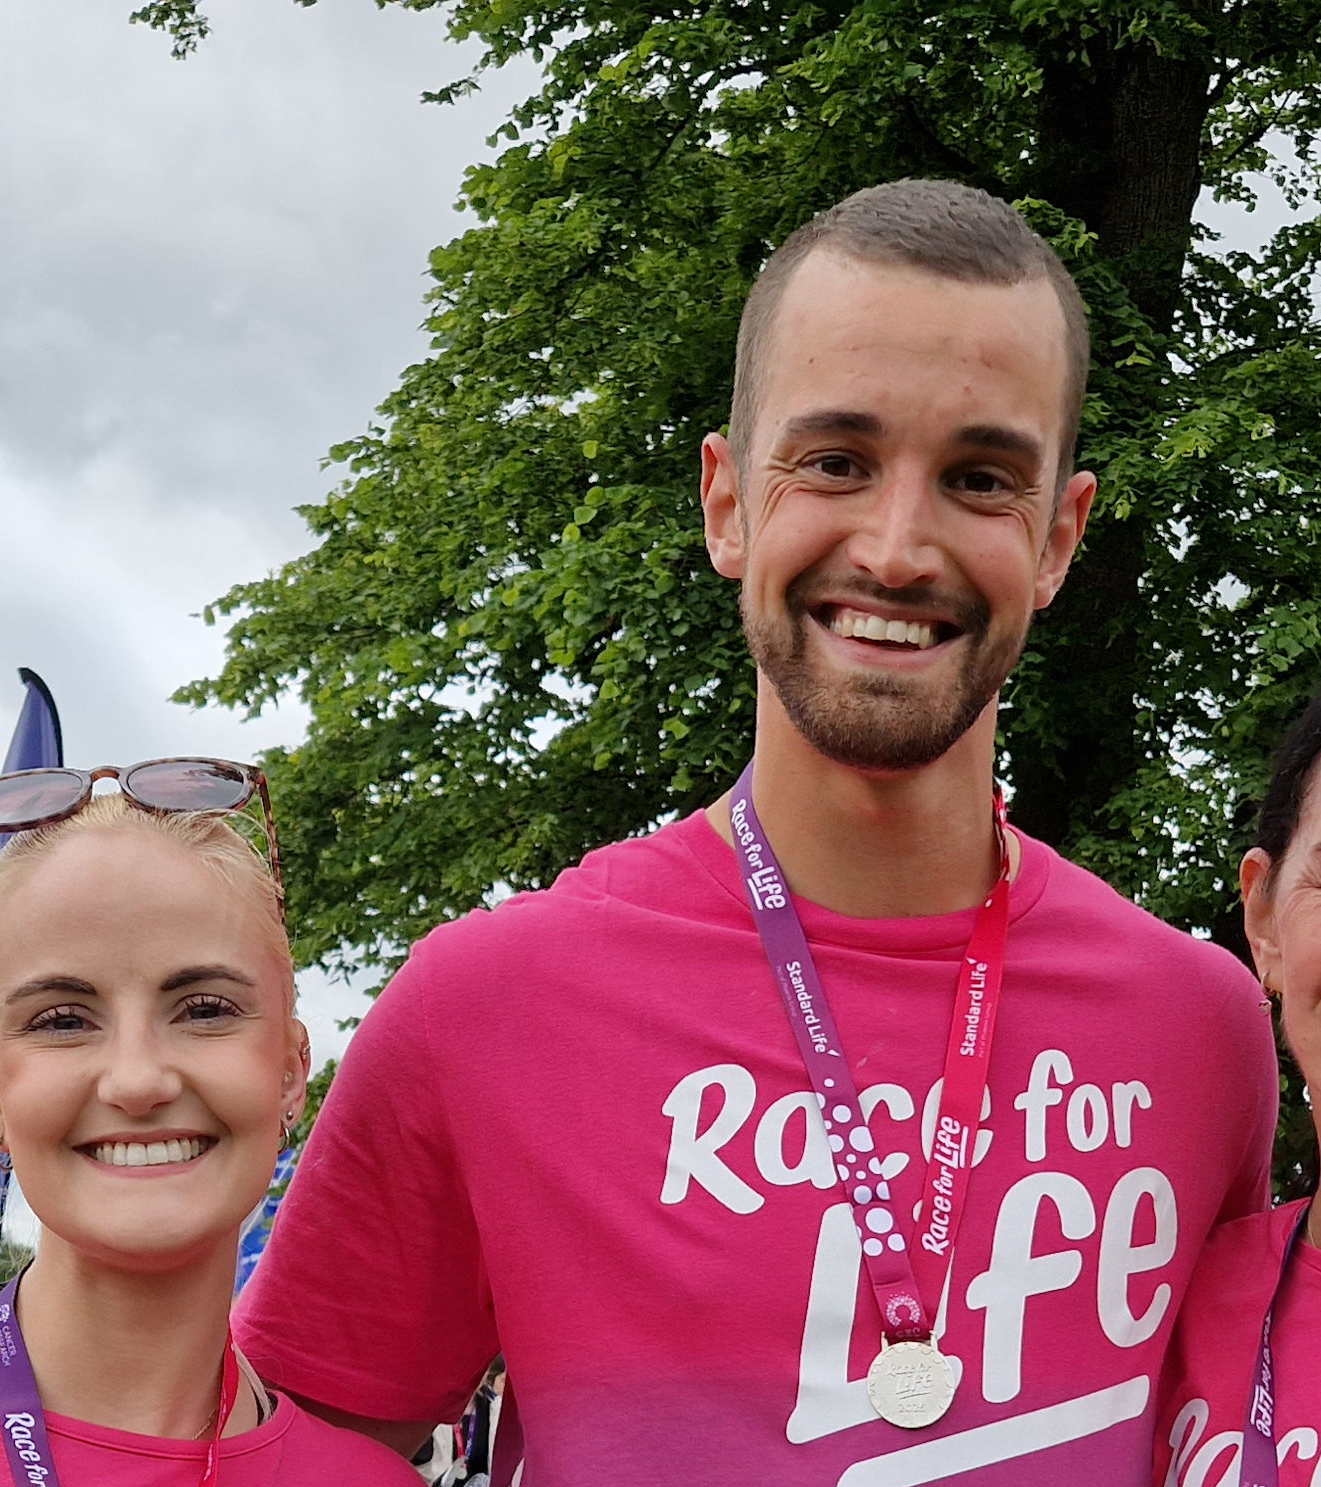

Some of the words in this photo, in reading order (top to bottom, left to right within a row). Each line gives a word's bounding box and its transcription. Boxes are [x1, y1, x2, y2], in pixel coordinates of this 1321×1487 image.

[727, 799, 754, 845] Race
[745, 844, 763, 868] for
[752, 867, 785, 908] Life
[971, 961, 987, 988] Life
[787, 962, 820, 1024] Standard
[808, 1025, 827, 1052] Life
[960, 991, 983, 1055] Standard
[1014, 1049, 1152, 1161] for
[934, 1117, 966, 1169] Life
[933, 1166, 957, 1195] for
[922, 1196, 951, 1255] Race
[1, 1325, 16, 1356] CANCER
[1256, 1385, 1273, 1436] Life
[5, 1413, 40, 1461] Race
